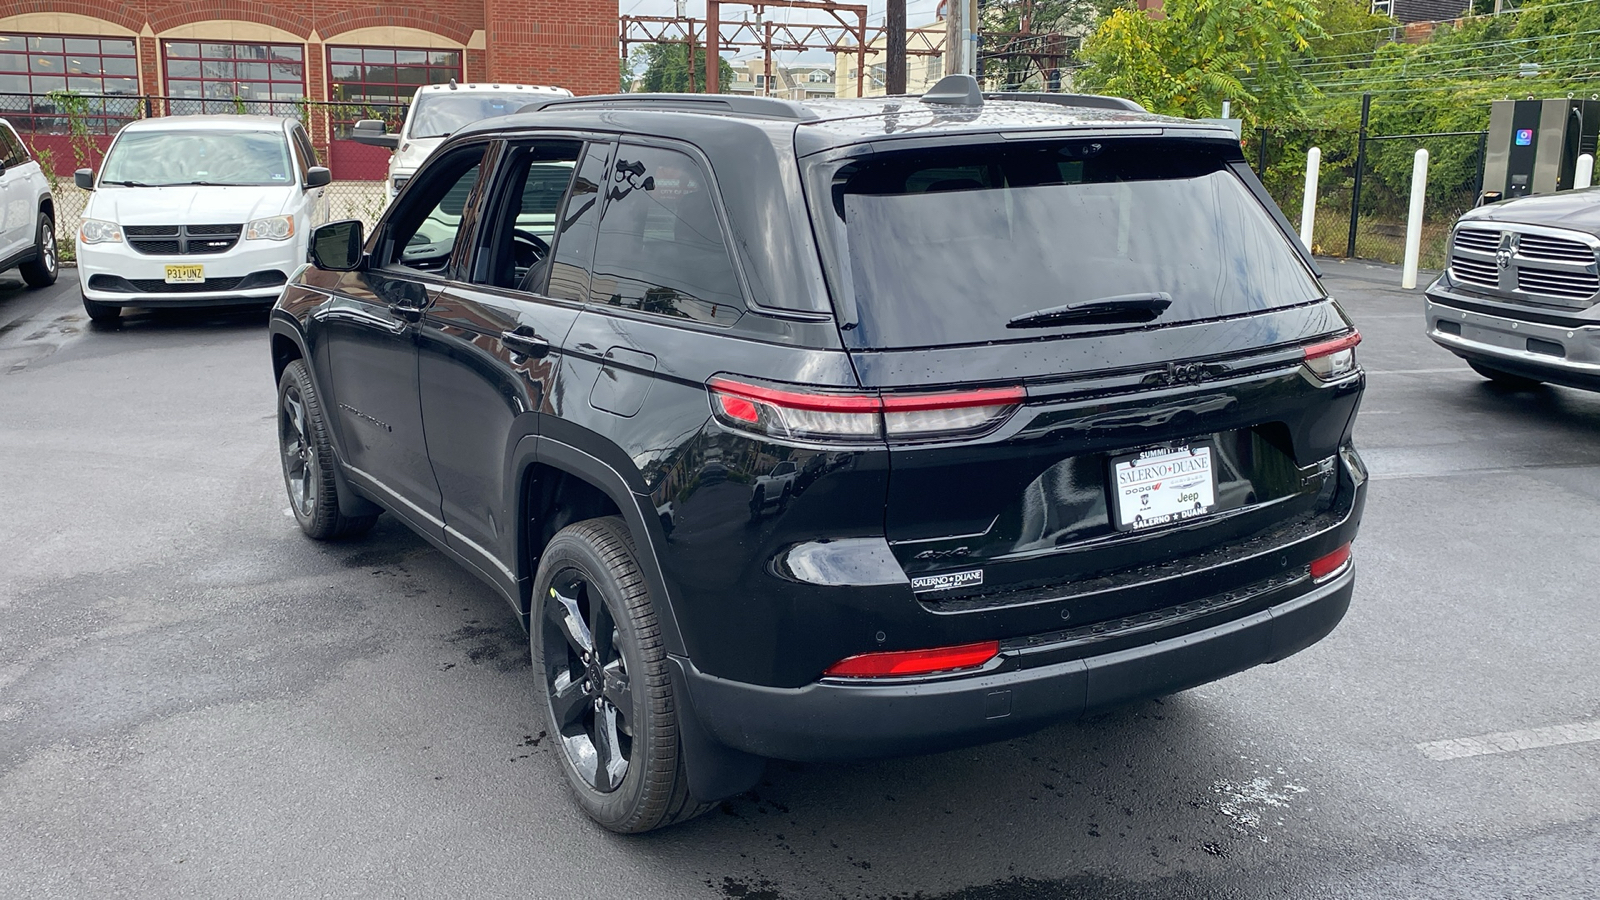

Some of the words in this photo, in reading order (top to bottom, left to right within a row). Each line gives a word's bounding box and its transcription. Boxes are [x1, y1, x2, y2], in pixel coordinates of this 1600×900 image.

[1119, 465, 1168, 485] SALERNO
[1173, 457, 1209, 475] DUANE
[1177, 492, 1199, 503] Jeep
[1132, 515, 1171, 530] SALERNO
[1181, 506, 1208, 519] DUANE
[913, 576, 948, 588] SALERNO
[954, 571, 981, 582] DUANE
